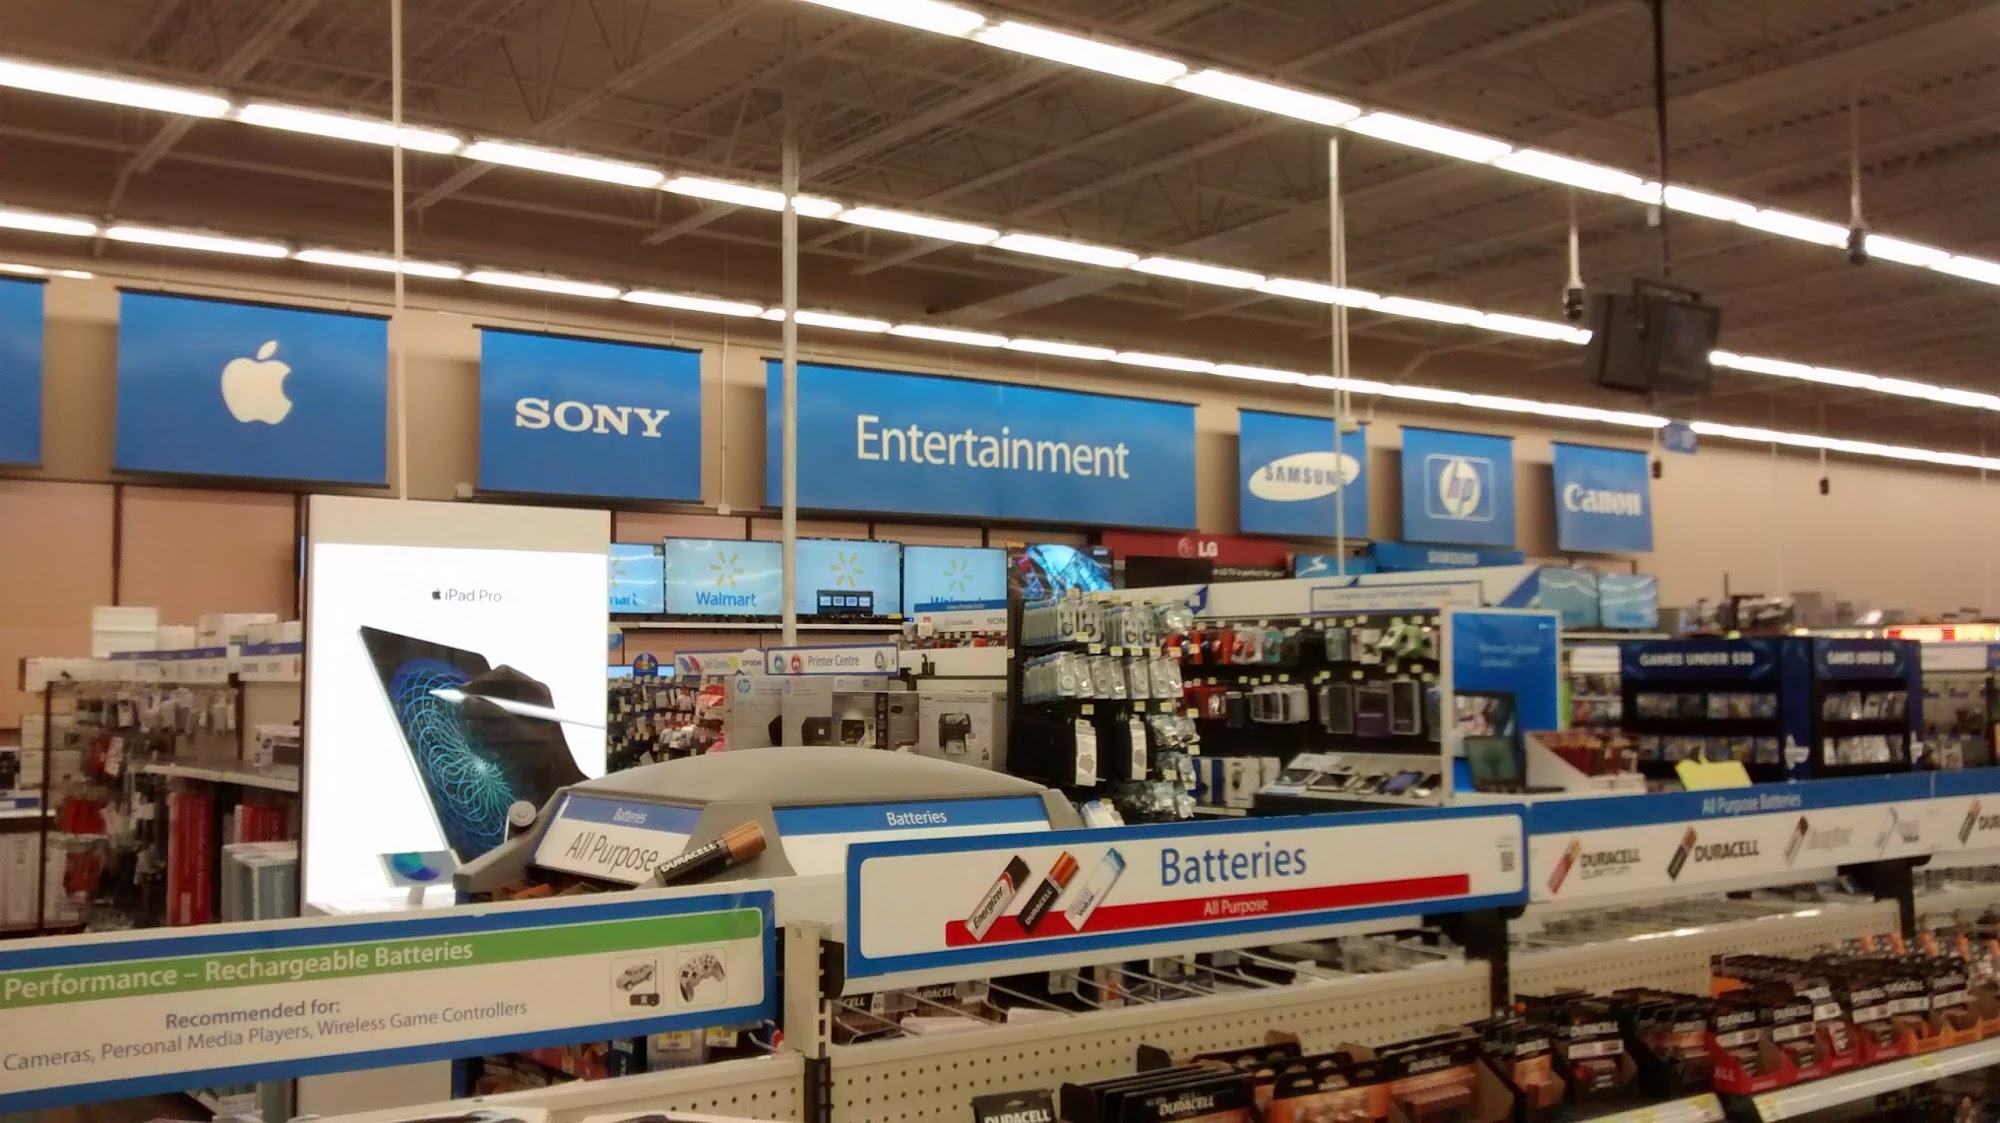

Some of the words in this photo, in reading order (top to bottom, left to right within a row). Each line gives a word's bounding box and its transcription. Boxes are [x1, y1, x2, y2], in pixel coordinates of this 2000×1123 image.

[515, 397, 670, 438] SONY
[857, 414, 1130, 479] Entertainment
[1265, 464, 1346, 486] SAMSUN
[1563, 482, 1642, 516] Canon
[1198, 541, 1219, 557] LG
[445, 588, 475, 602] iPad
[479, 589, 502, 603] Pro
[695, 591, 757, 606] Walmart
[807, 655, 834, 667] Printer
[835, 654, 860, 666] Centre
[613, 807, 648, 825] Batteries
[886, 810, 948, 826] Batteries
[565, 831, 592, 861] All
[592, 834, 659, 873] Purpose
[660, 842, 718, 873] DURACELL
[1580, 849, 1640, 868] DURACELL
[1694, 840, 1759, 863] DURACELL
[1161, 841, 1307, 887] Batteries
[973, 886, 1005, 930] Energizer
[1024, 889, 1053, 926] DURACELL
[1204, 900, 1219, 917] All
[1221, 898, 1269, 917] Purpose
[5, 967, 177, 1001] Performance
[205, 949, 368, 982] Rechargeable
[374, 941, 473, 968] Batteries
[843, 996, 866, 1007] CELL
[915, 987, 957, 999] URACELL
[166, 1000, 305, 1030] Recommended
[310, 998, 341, 1014] for:
[3, 1048, 95, 1072] Cameras,
[102, 1036, 181, 1060] Personal
[188, 1030, 243, 1051] Media
[249, 1024, 314, 1045] Players,
[318, 1016, 386, 1036] Wireless
[390, 1010, 438, 1029] Game
[442, 1001, 527, 1023] Controllers
